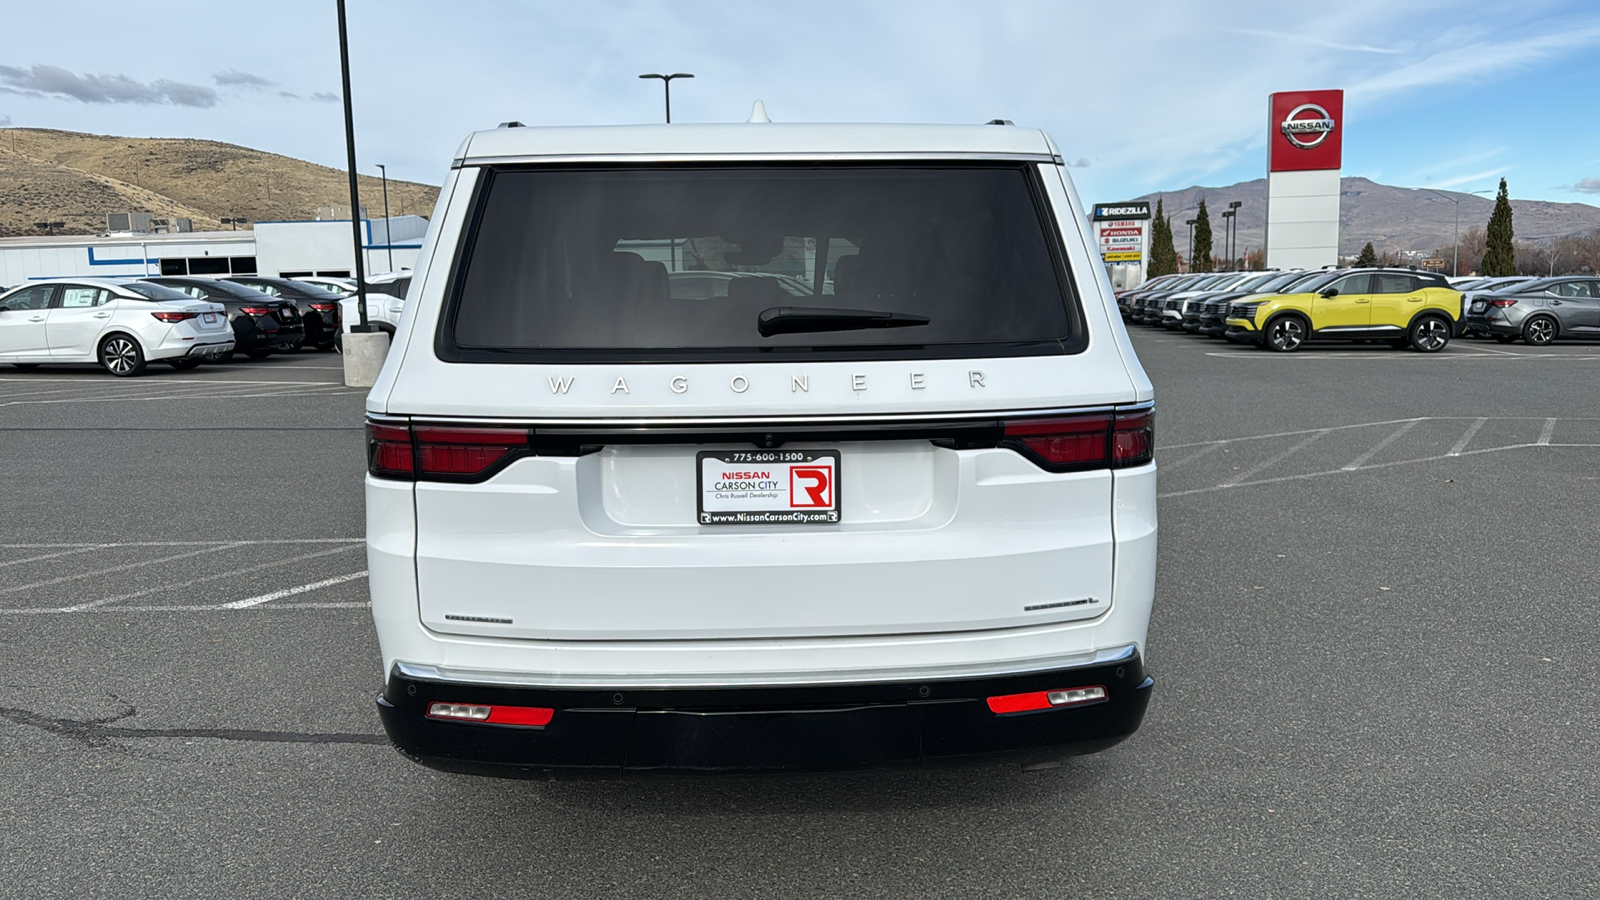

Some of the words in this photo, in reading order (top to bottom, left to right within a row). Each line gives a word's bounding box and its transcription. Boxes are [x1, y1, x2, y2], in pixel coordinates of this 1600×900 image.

[1287, 121, 1330, 130] NISSAN
[1109, 206, 1148, 215] RIDEZILLA
[547, 370, 986, 395] WAGONEER
[733, 453, 804, 462] 775-600-1500
[722, 471, 770, 480] NISSAN
[714, 481, 756, 490] CARSON
[758, 481, 779, 490] CITY
[715, 492, 730, 500] Chris
[749, 492, 779, 500] Dealership
[712, 512, 827, 523] www.NissanCarsonCity.com
